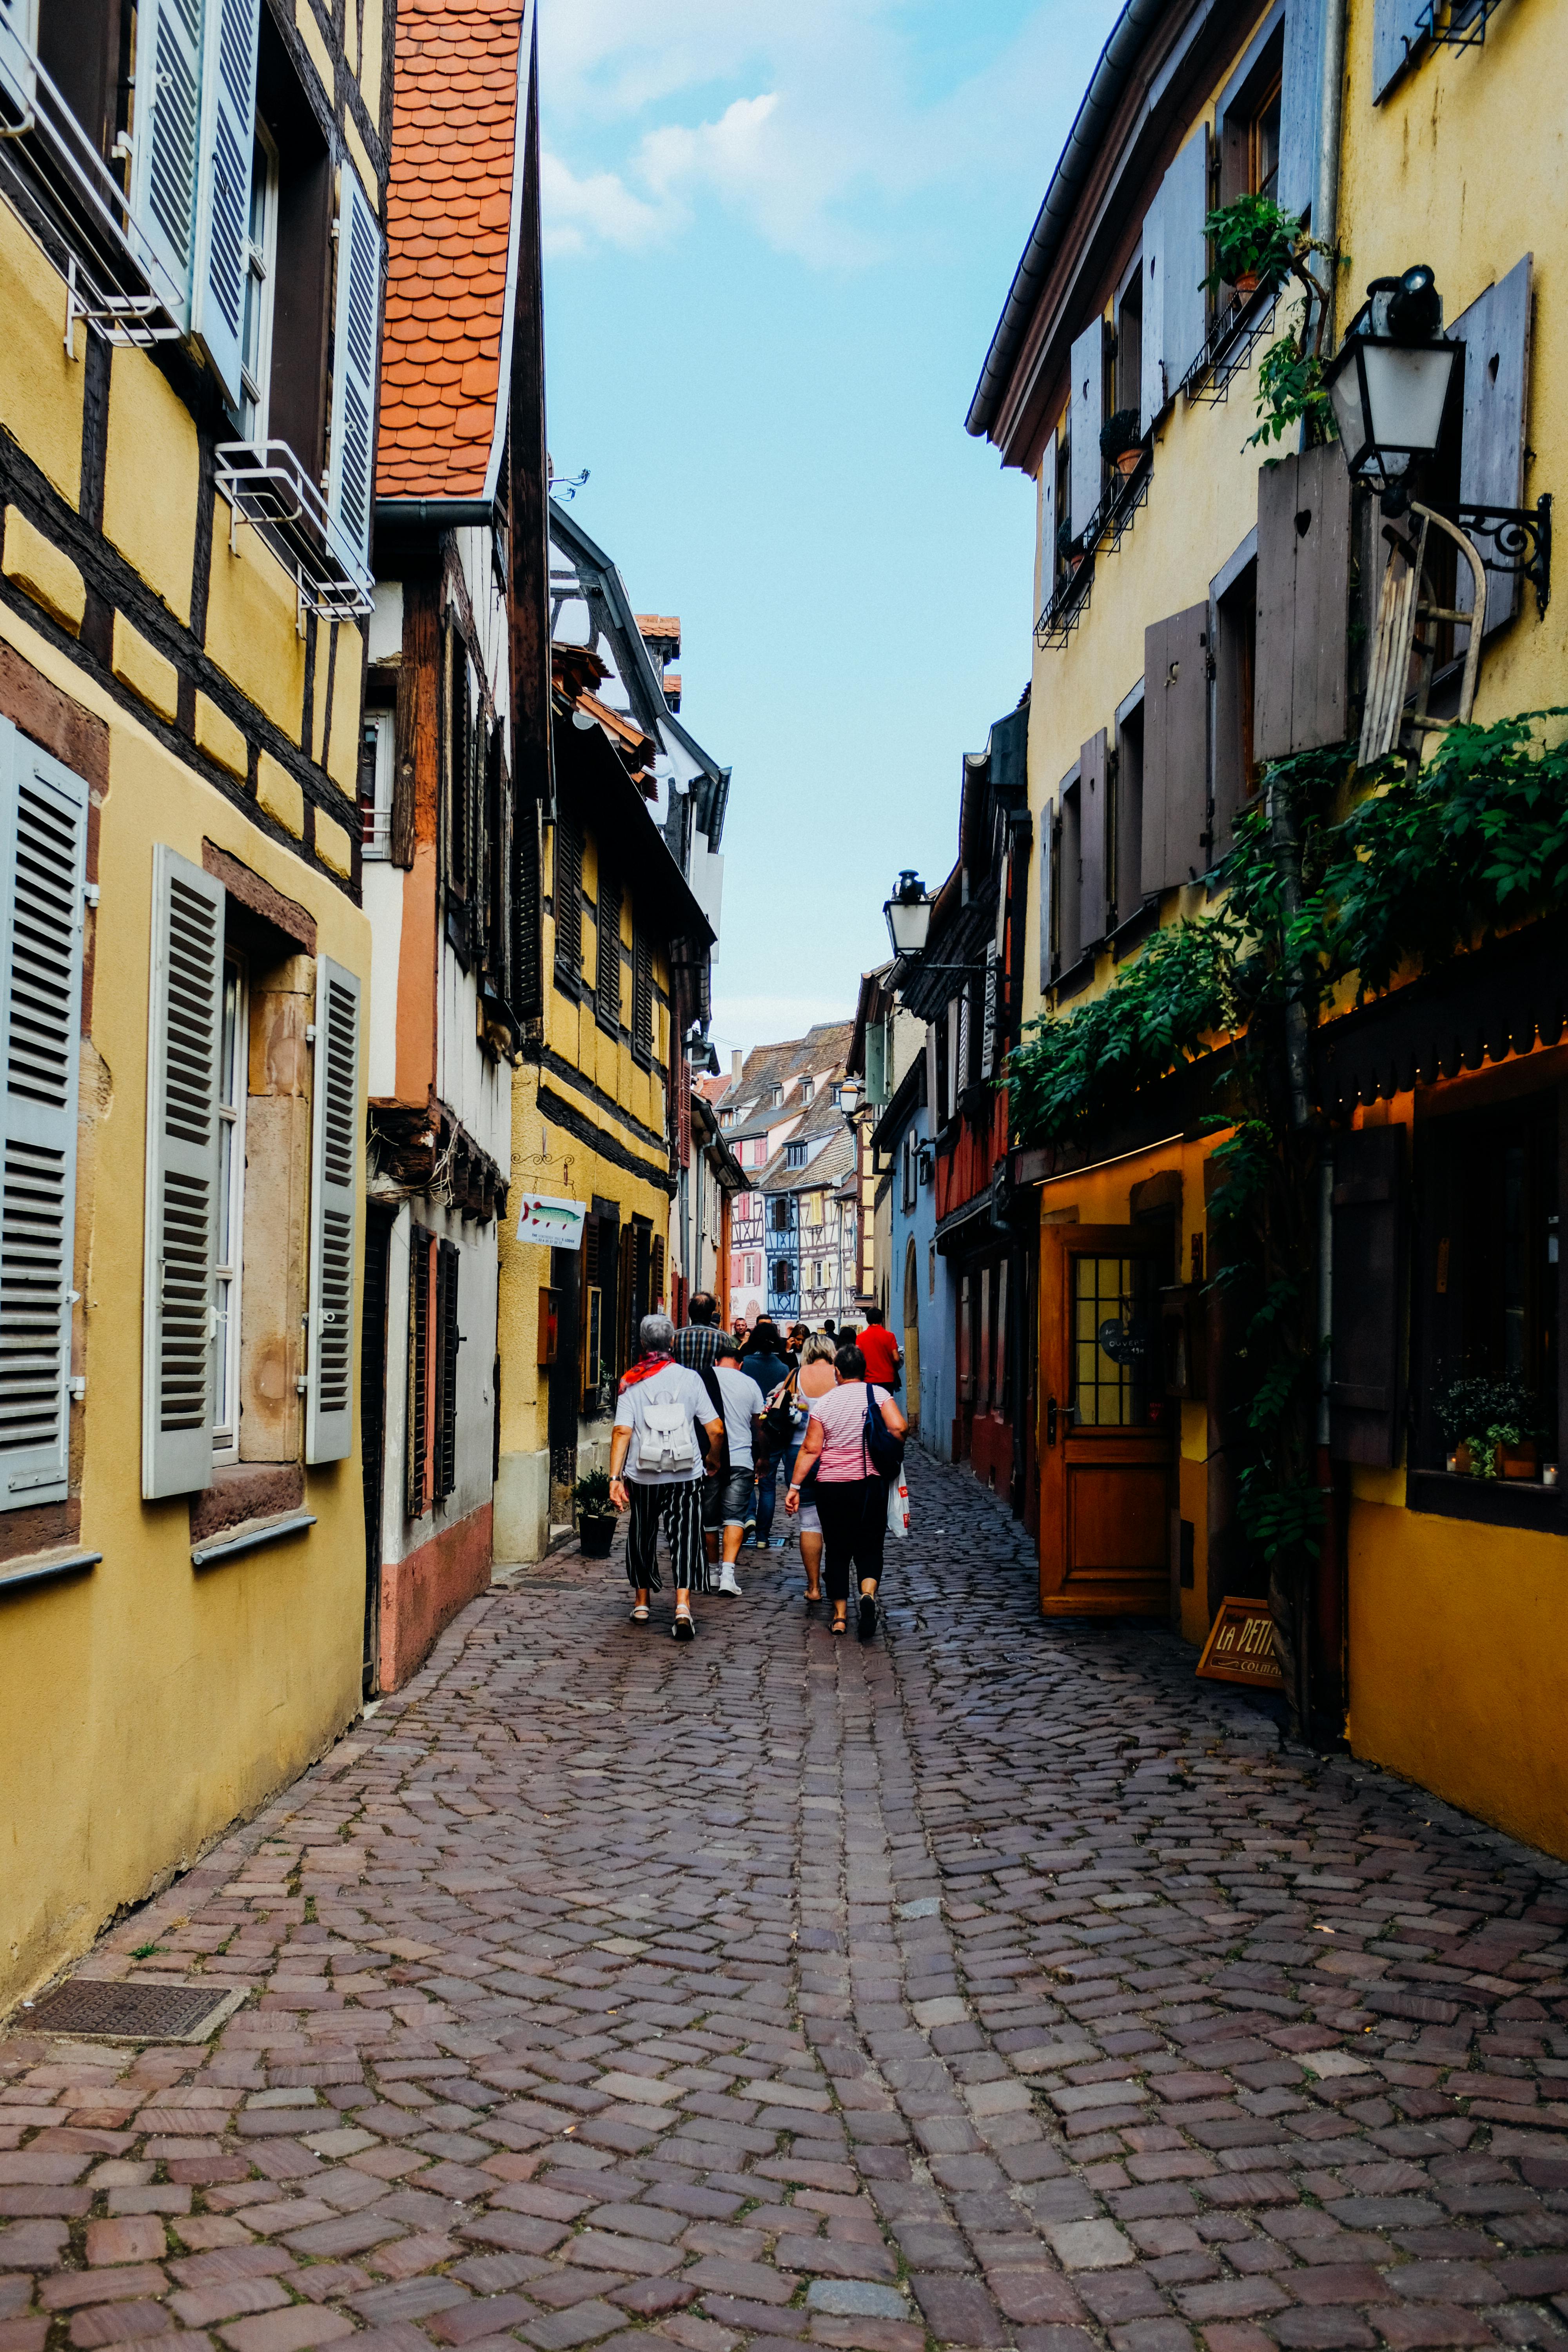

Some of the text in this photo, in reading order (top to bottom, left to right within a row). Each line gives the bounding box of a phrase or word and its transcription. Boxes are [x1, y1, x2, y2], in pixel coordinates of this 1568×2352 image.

[1216, 1618, 1276, 1657] LA PETI
[1241, 1661, 1282, 1675] COLMA
